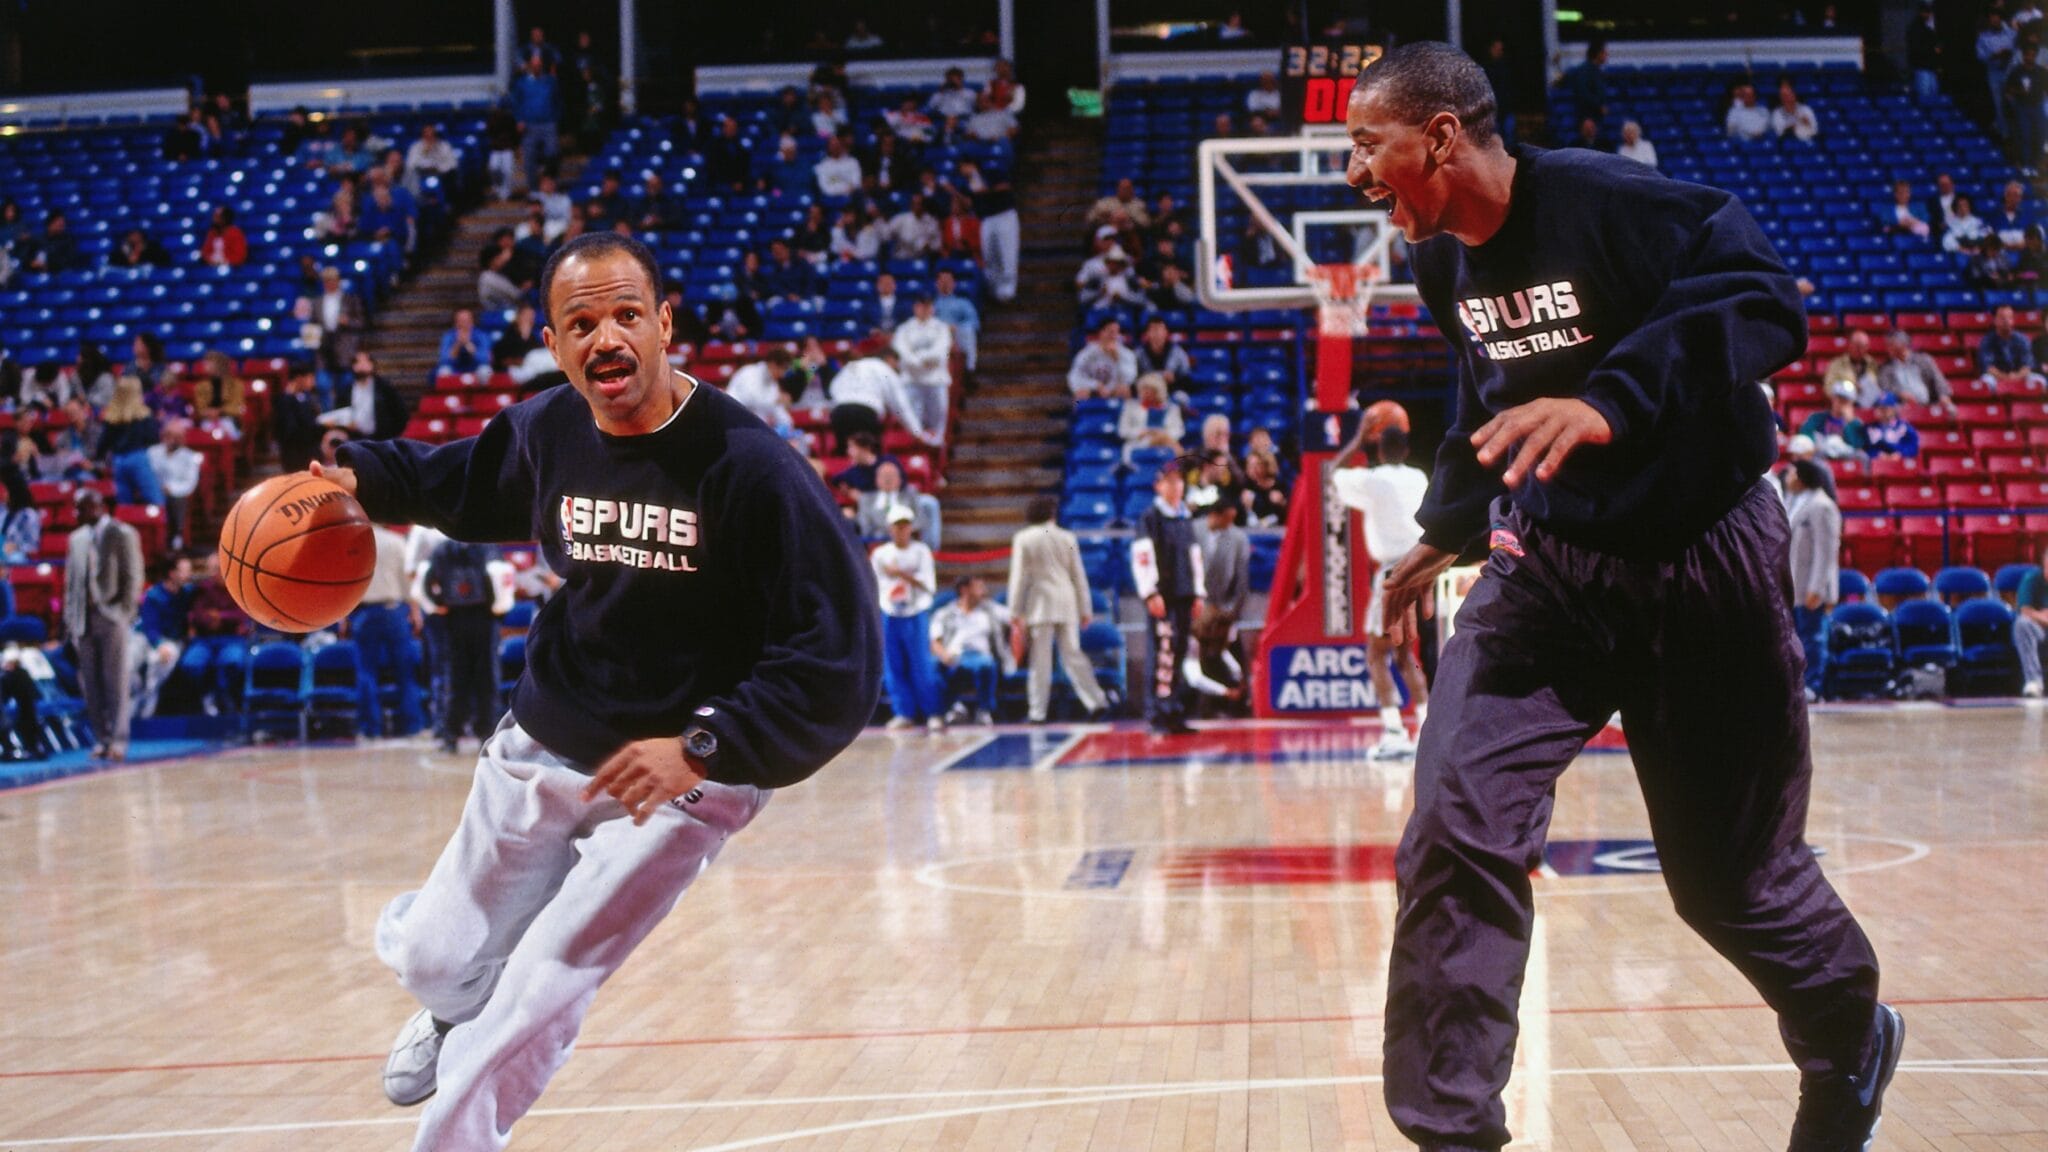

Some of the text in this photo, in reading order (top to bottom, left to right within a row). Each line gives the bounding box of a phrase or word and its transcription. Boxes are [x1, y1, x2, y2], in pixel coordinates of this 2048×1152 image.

[1466, 281, 1581, 333] SPURS
[1484, 326, 1594, 360] ASKETBALL
[572, 497, 698, 546] SPURS
[572, 541, 698, 572] BASKETBALL
[1288, 647, 1392, 677] ARC
